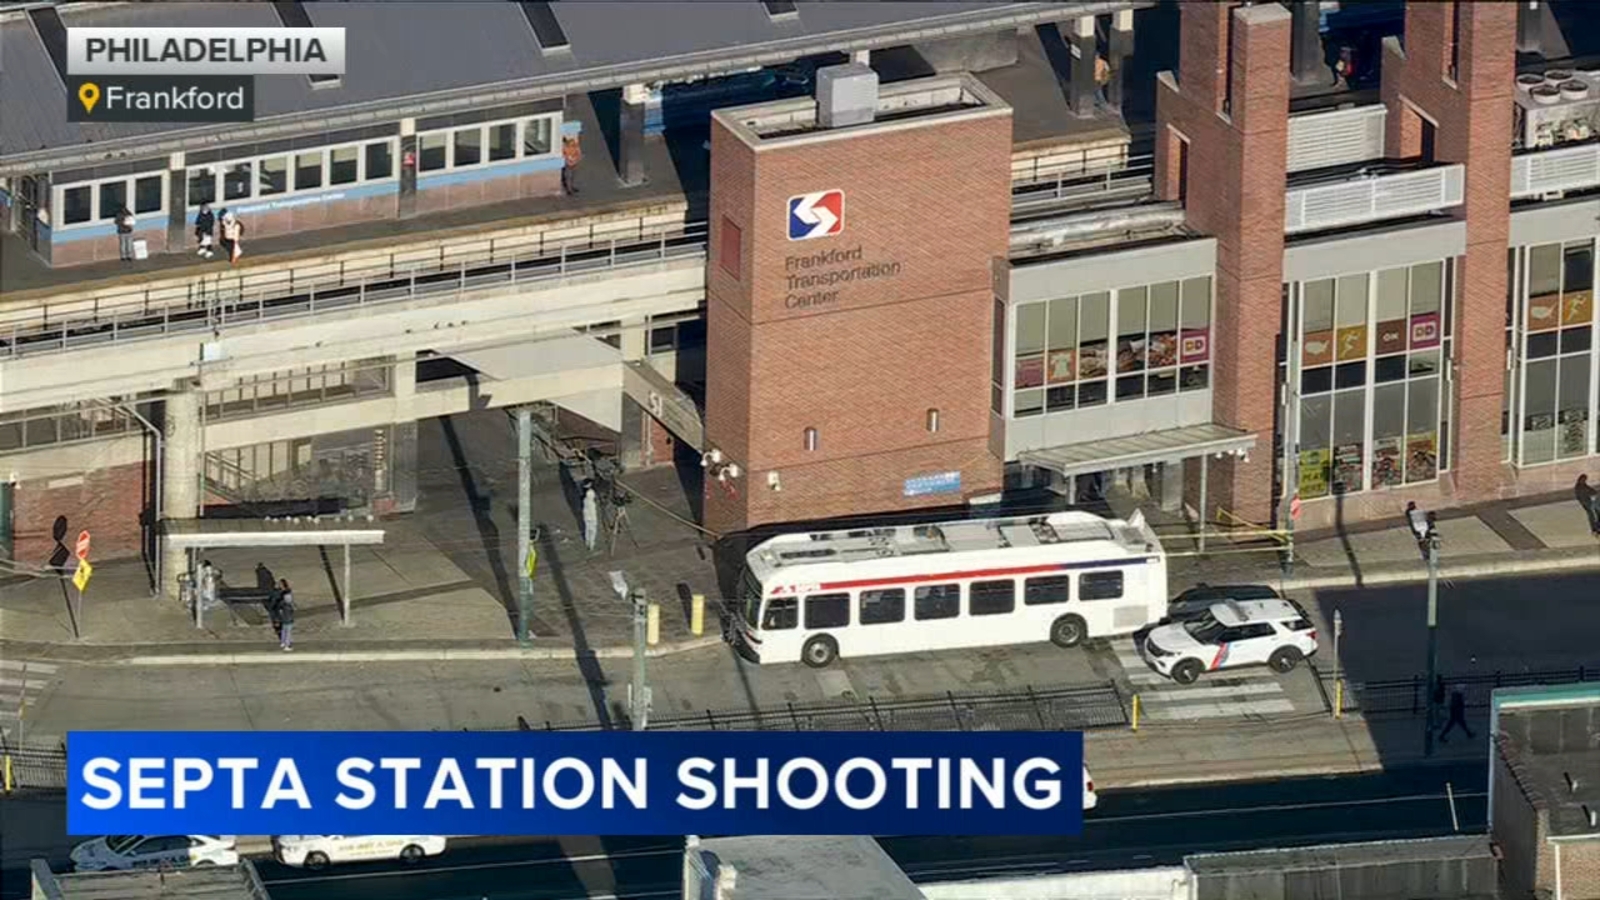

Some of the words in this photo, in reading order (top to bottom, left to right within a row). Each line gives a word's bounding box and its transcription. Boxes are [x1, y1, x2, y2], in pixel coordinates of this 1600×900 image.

[785, 245, 863, 271] Frankford
[786, 261, 902, 290] Transportation
[785, 291, 839, 309] Center
